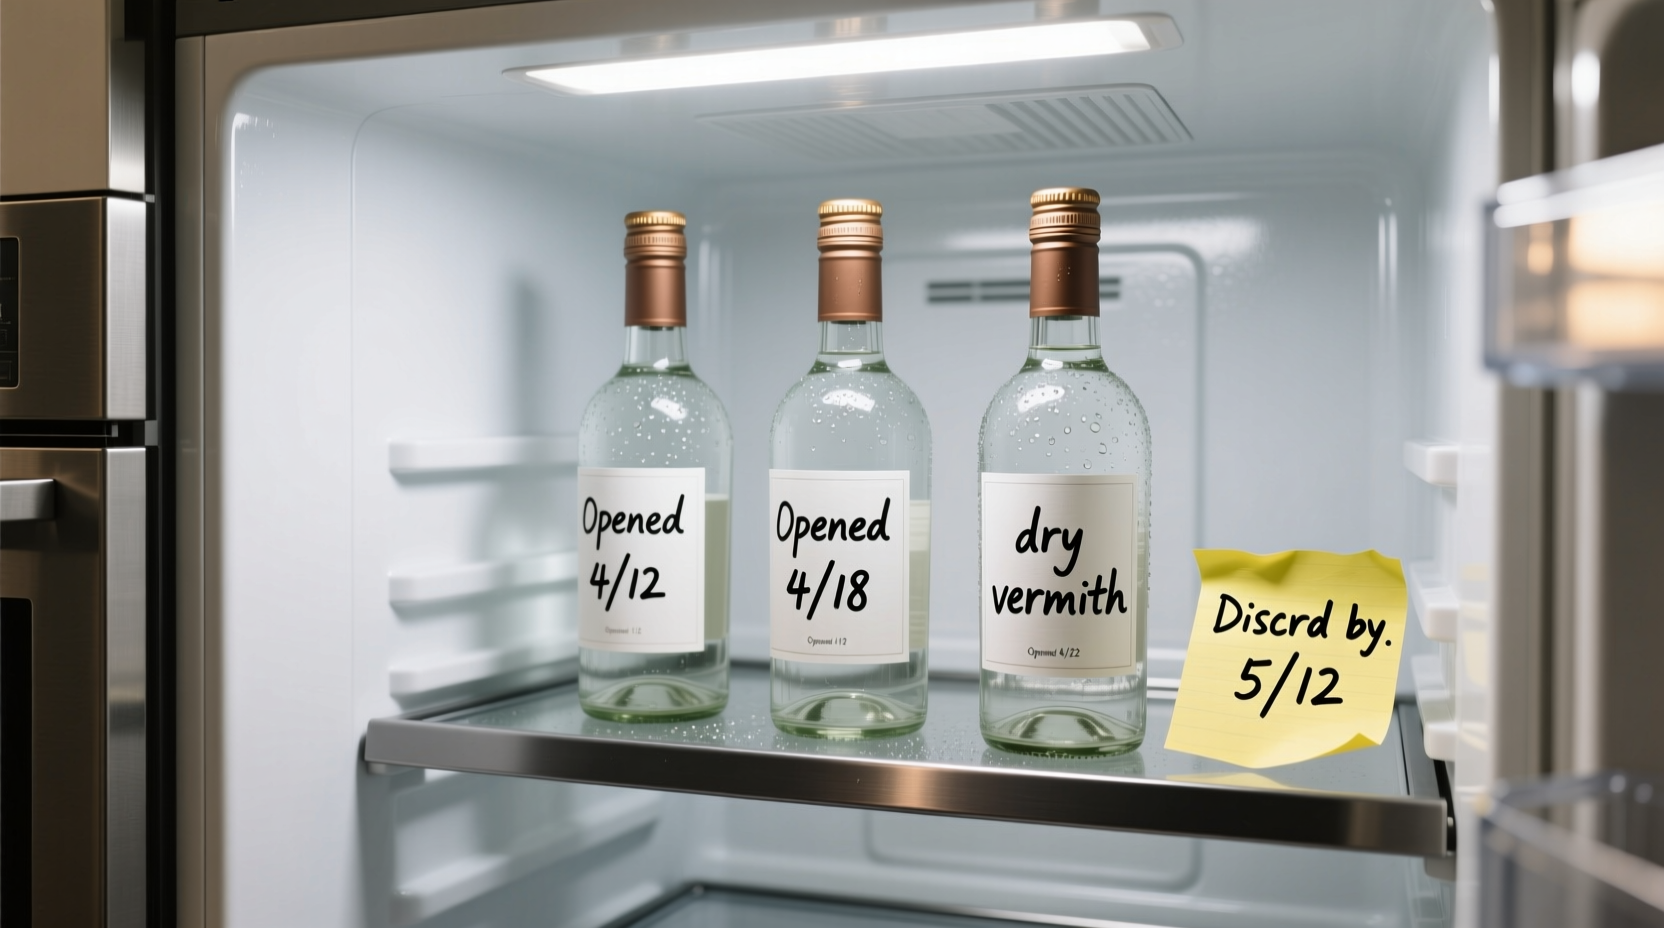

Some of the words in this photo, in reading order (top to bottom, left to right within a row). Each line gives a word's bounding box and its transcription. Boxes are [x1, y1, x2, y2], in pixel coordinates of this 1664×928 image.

[582, 494, 685, 551] Opened
[776, 497, 891, 559] Opened
[1015, 505, 1084, 578] dry
[589, 552, 666, 612] 4/12
[786, 559, 870, 621] 4/18
[992, 567, 1128, 616] vermith
[1059, 646, 1081, 660] 4/22
[1212, 593, 1334, 639] Discrd
[1345, 602, 1393, 658] by.
[1234, 651, 1344, 719] 5/12
